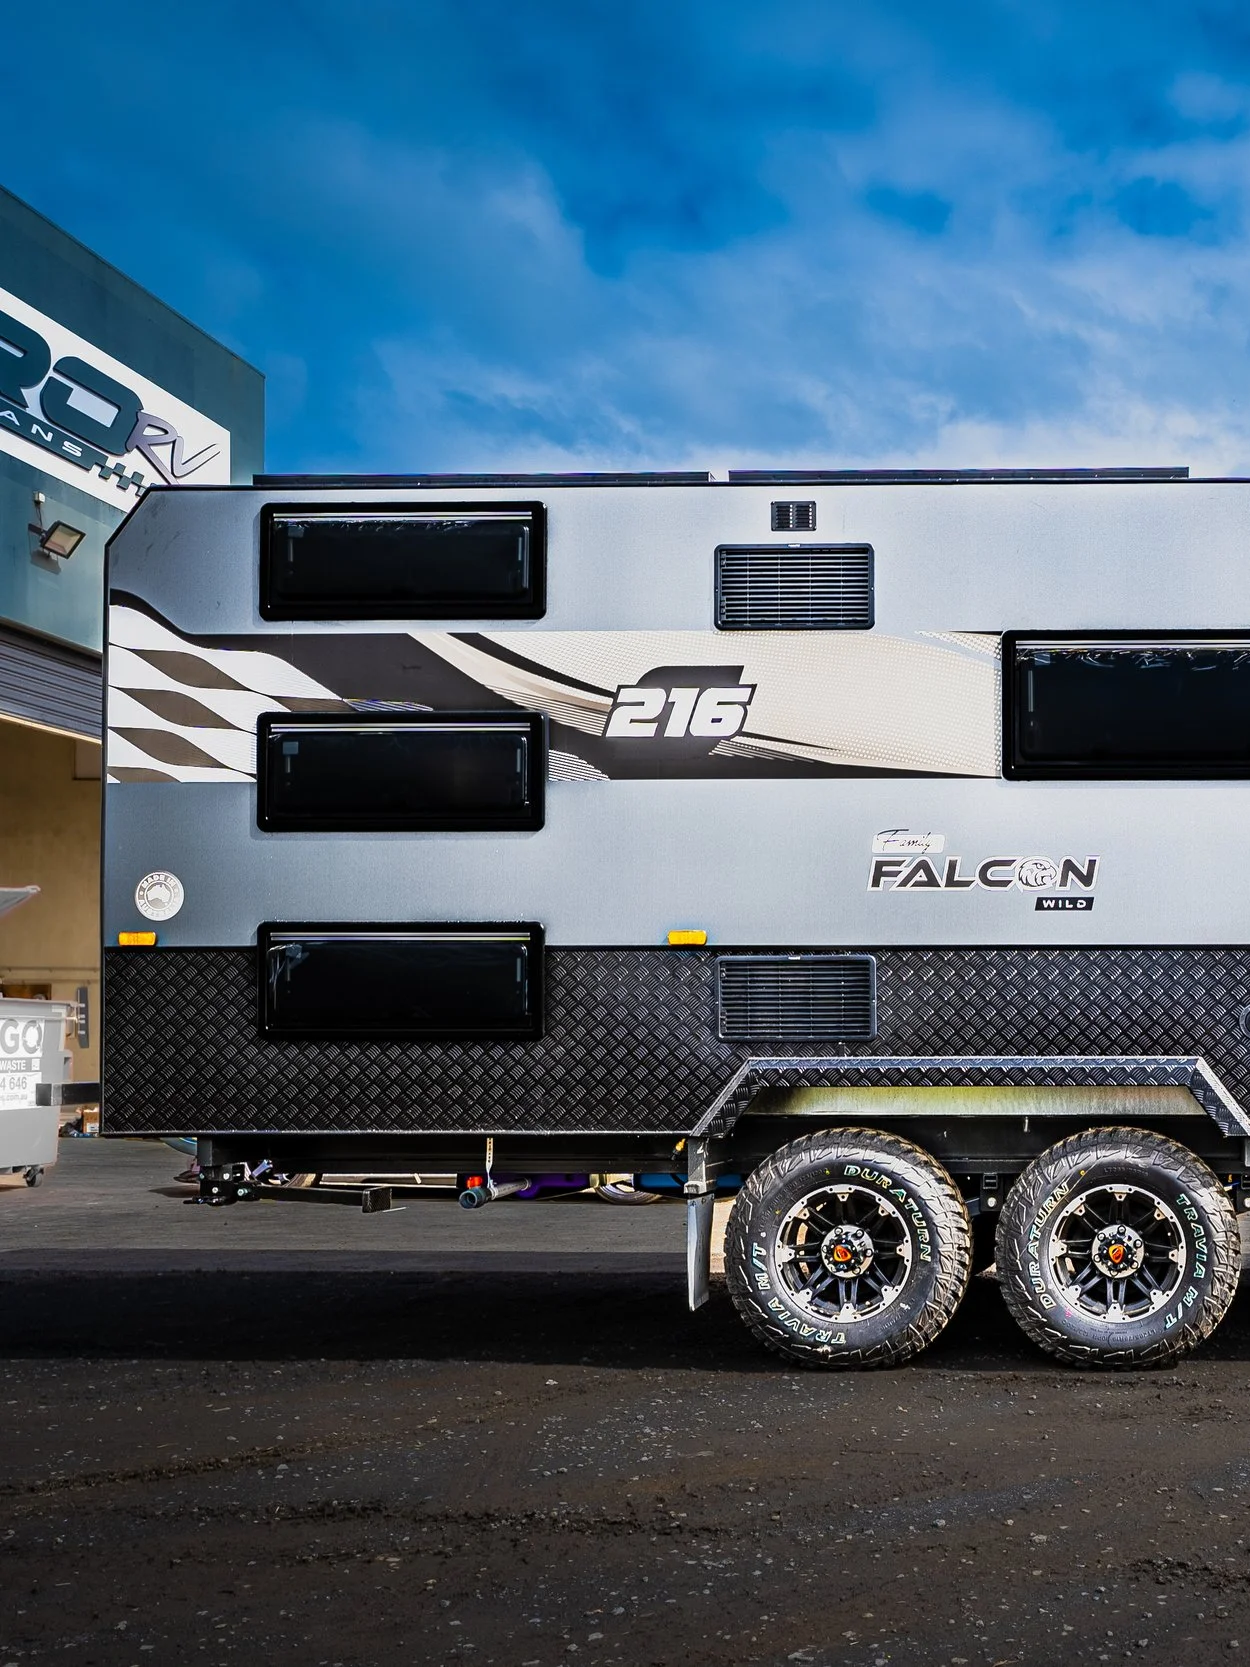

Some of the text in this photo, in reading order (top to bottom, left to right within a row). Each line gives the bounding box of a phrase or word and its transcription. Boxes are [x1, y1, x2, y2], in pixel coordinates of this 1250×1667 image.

[606, 687, 752, 737] 216
[877, 828, 932, 855] Family
[870, 857, 1098, 890] FALCON
[1042, 899, 1087, 909] WILD
[0, 1059, 26, 1071] WASTE
[843, 1165, 932, 1262] DURATURN
[1176, 1192, 1208, 1279] TRAVIA
[1028, 1182, 1070, 1310] DURATURN
[767, 1296, 846, 1344] TRAVIA
